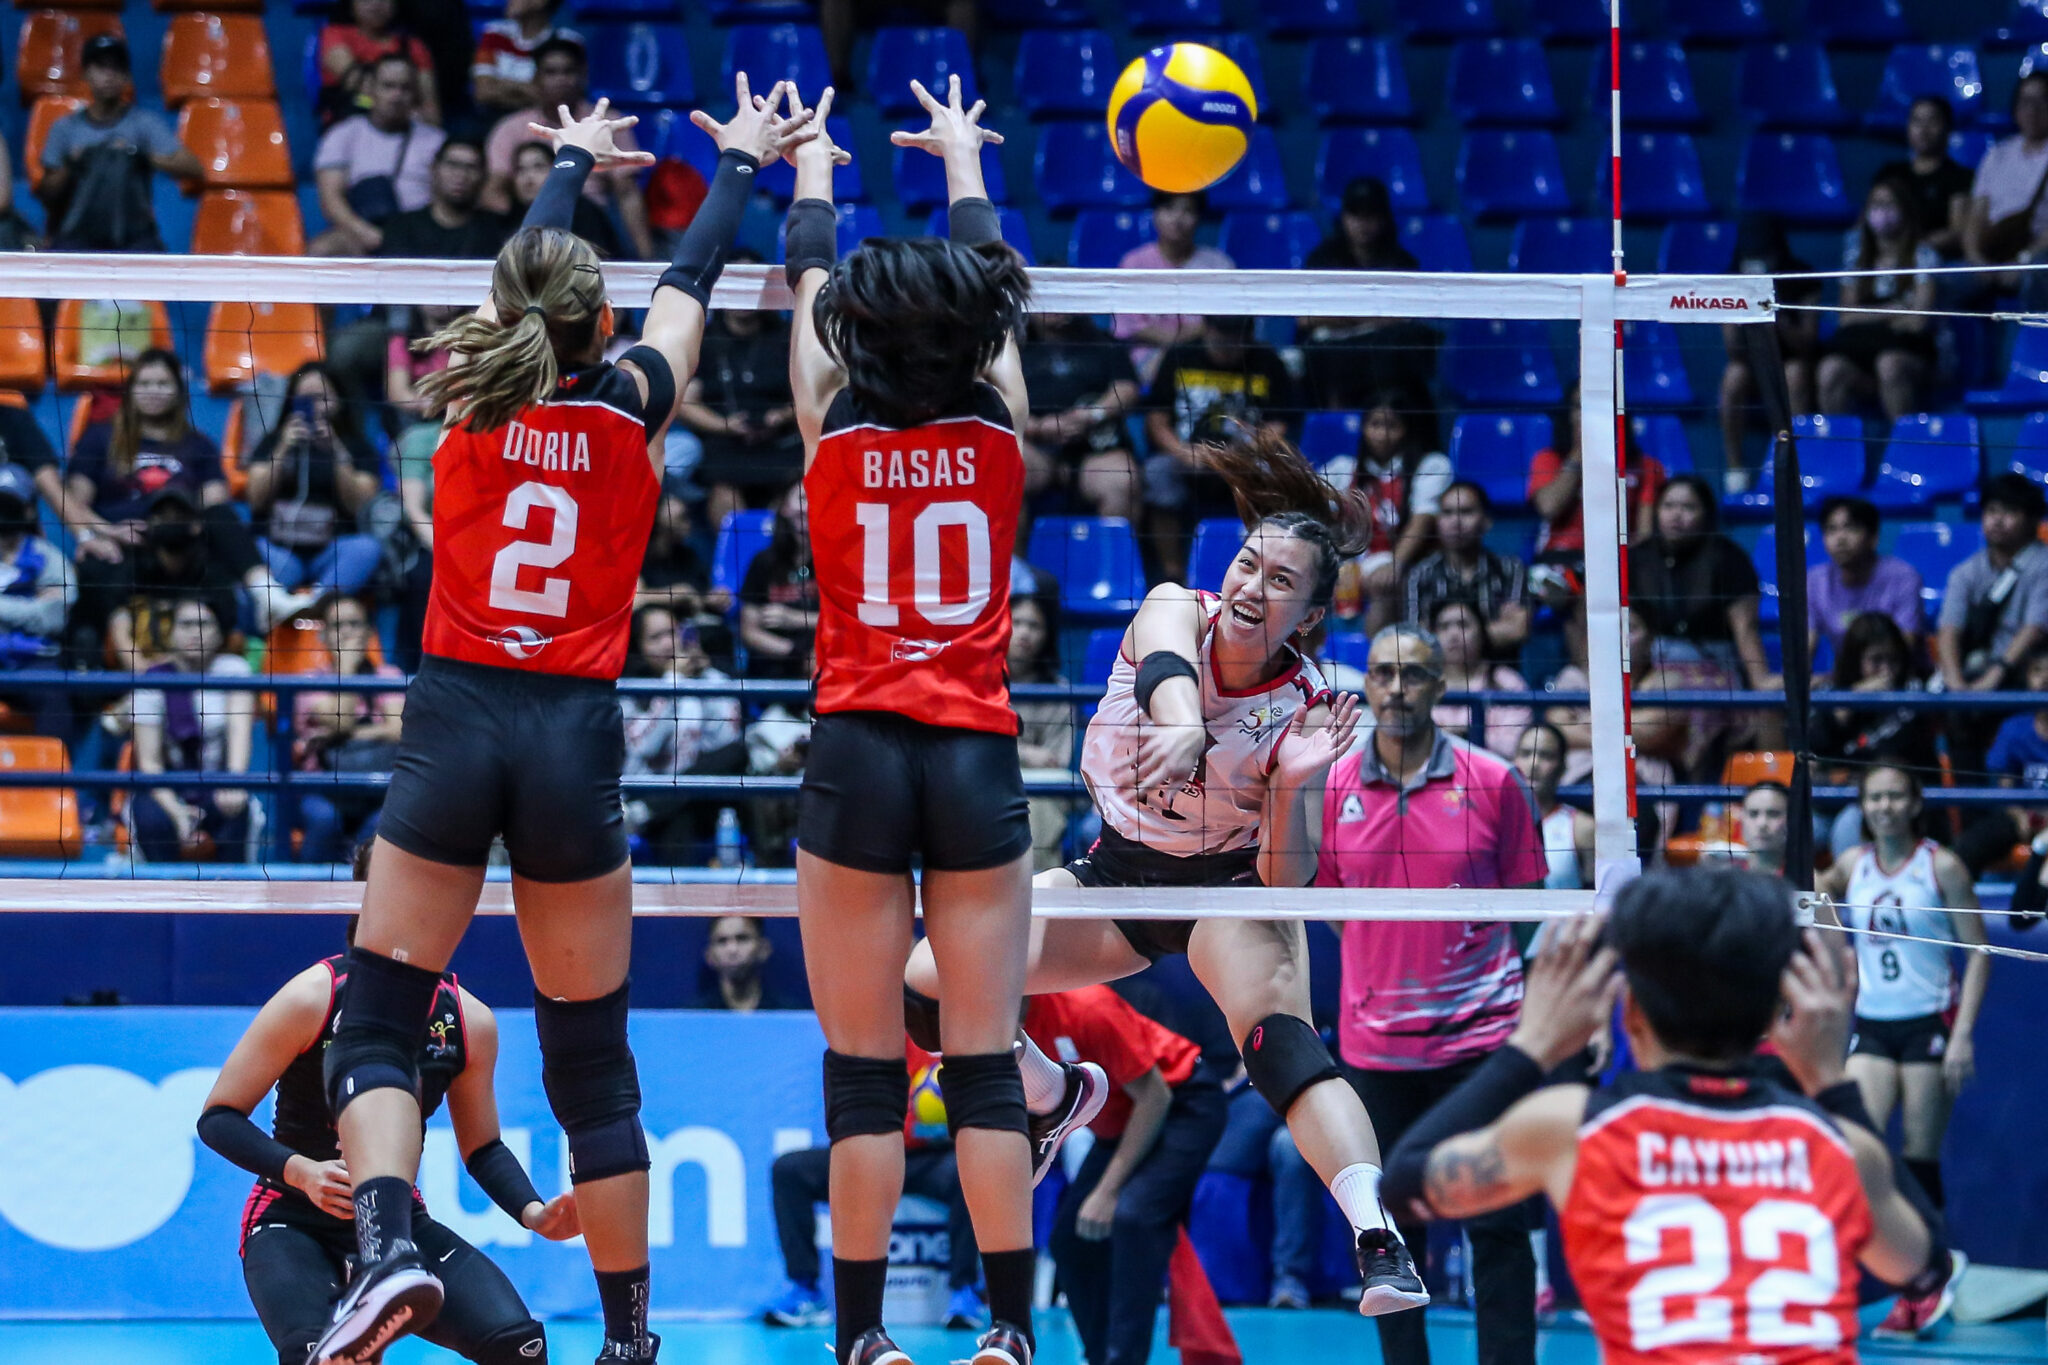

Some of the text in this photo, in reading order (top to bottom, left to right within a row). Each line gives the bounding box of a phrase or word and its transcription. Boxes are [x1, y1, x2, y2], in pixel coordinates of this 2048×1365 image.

[502, 420, 591, 472] DORIA
[864, 447, 975, 488] BASAS
[489, 480, 579, 618] 2
[856, 500, 991, 626] 10
[1881, 950, 1901, 982] 9
[1636, 1131, 1813, 1193] CAYUNA
[1621, 1193, 1843, 1351] 22
